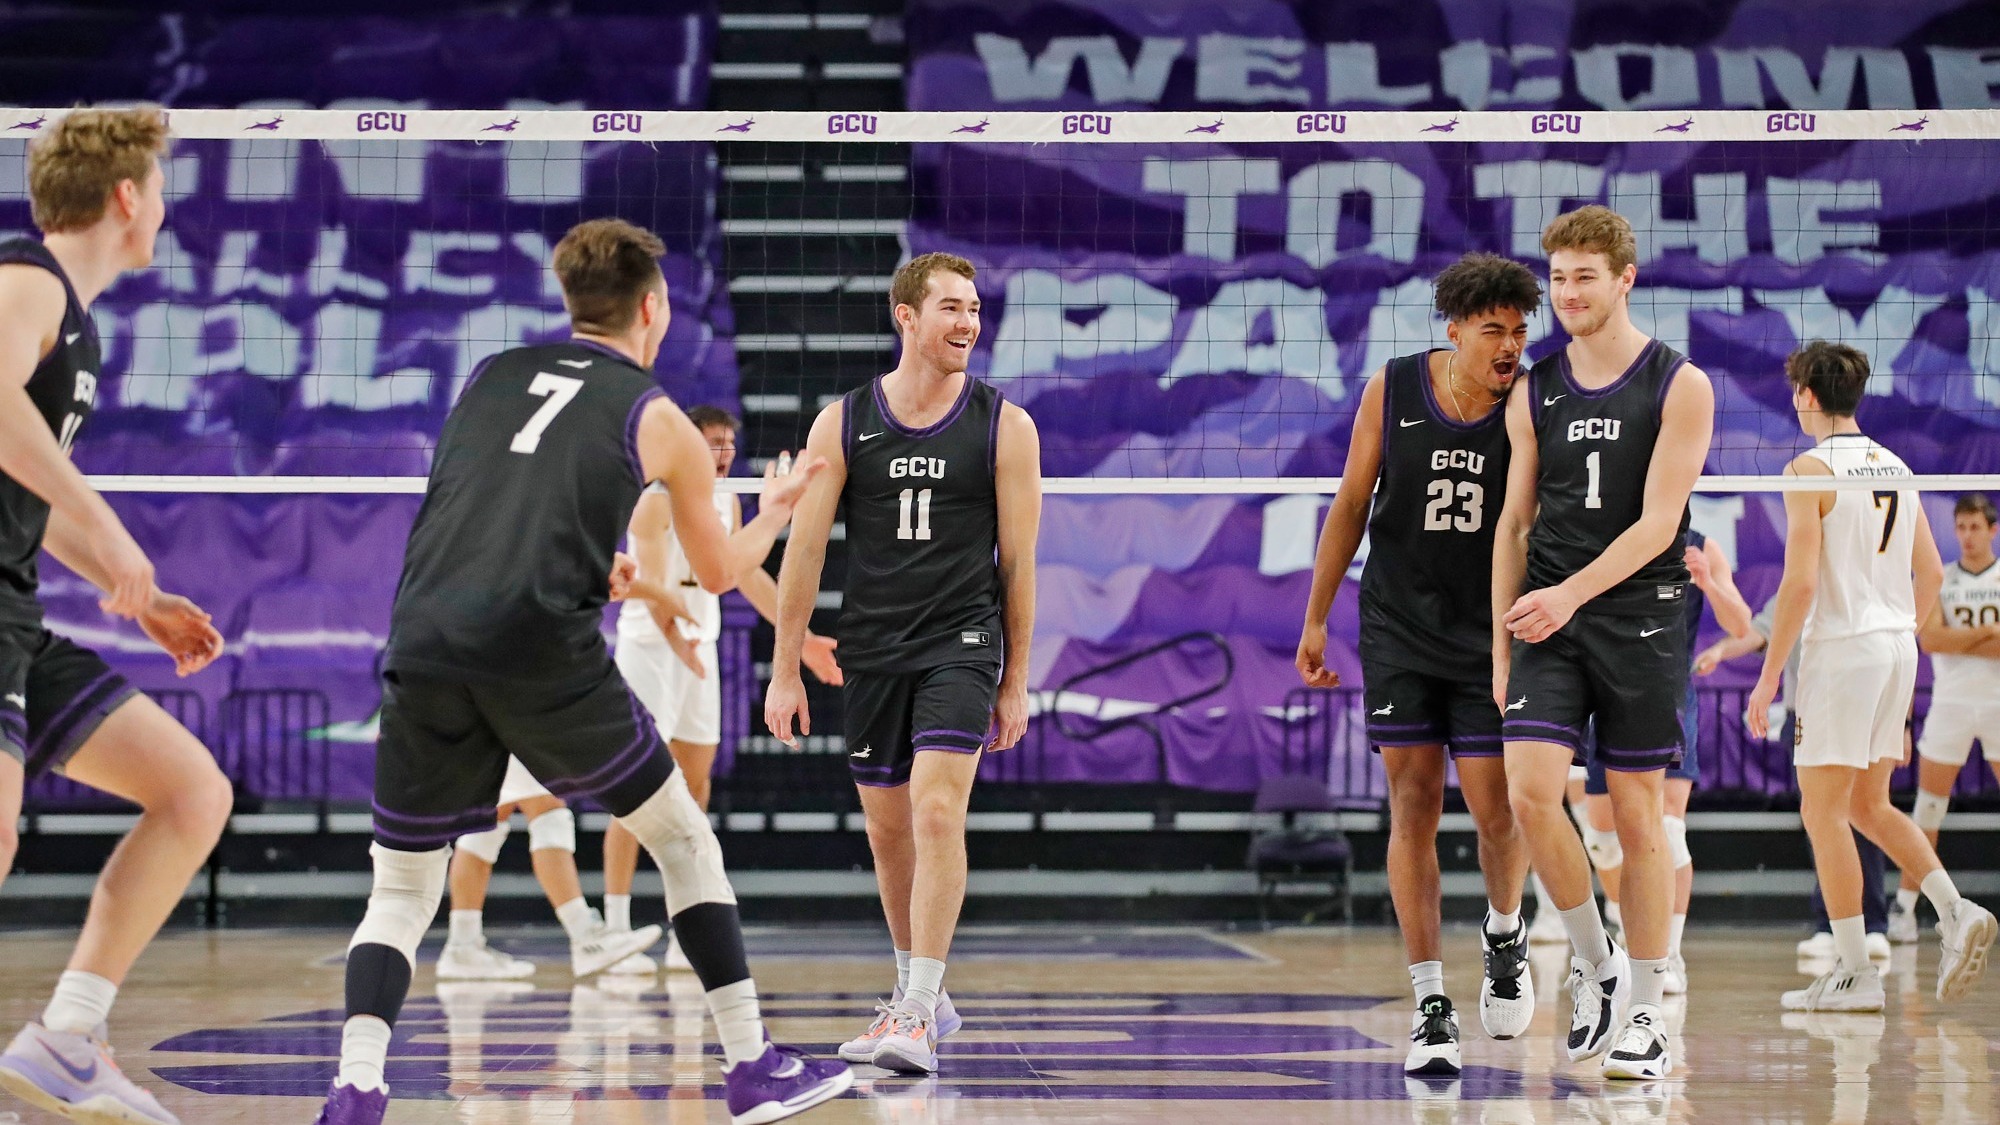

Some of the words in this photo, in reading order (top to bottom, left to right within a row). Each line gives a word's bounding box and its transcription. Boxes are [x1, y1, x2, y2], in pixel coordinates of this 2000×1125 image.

[973, 32, 2000, 110] WELCOME
[357, 112, 406, 133] GCU
[592, 113, 641, 134] GCU
[828, 113, 877, 135] GCU
[1062, 114, 1112, 135] GCU
[1297, 113, 1347, 134] GCU
[1531, 113, 1582, 134] GCU
[1766, 112, 1816, 133] GCU
[1142, 156, 1426, 270] TO
[1472, 158, 1890, 268] THE
[511, 371, 585, 455] 7
[1566, 417, 1622, 443] GCU
[889, 456, 947, 480] GCU
[1430, 449, 1486, 475] GCU
[1584, 451, 1602, 509] 1
[897, 488, 932, 540] 11
[1424, 478, 1485, 533] 23
[1872, 490, 1899, 554] 7
